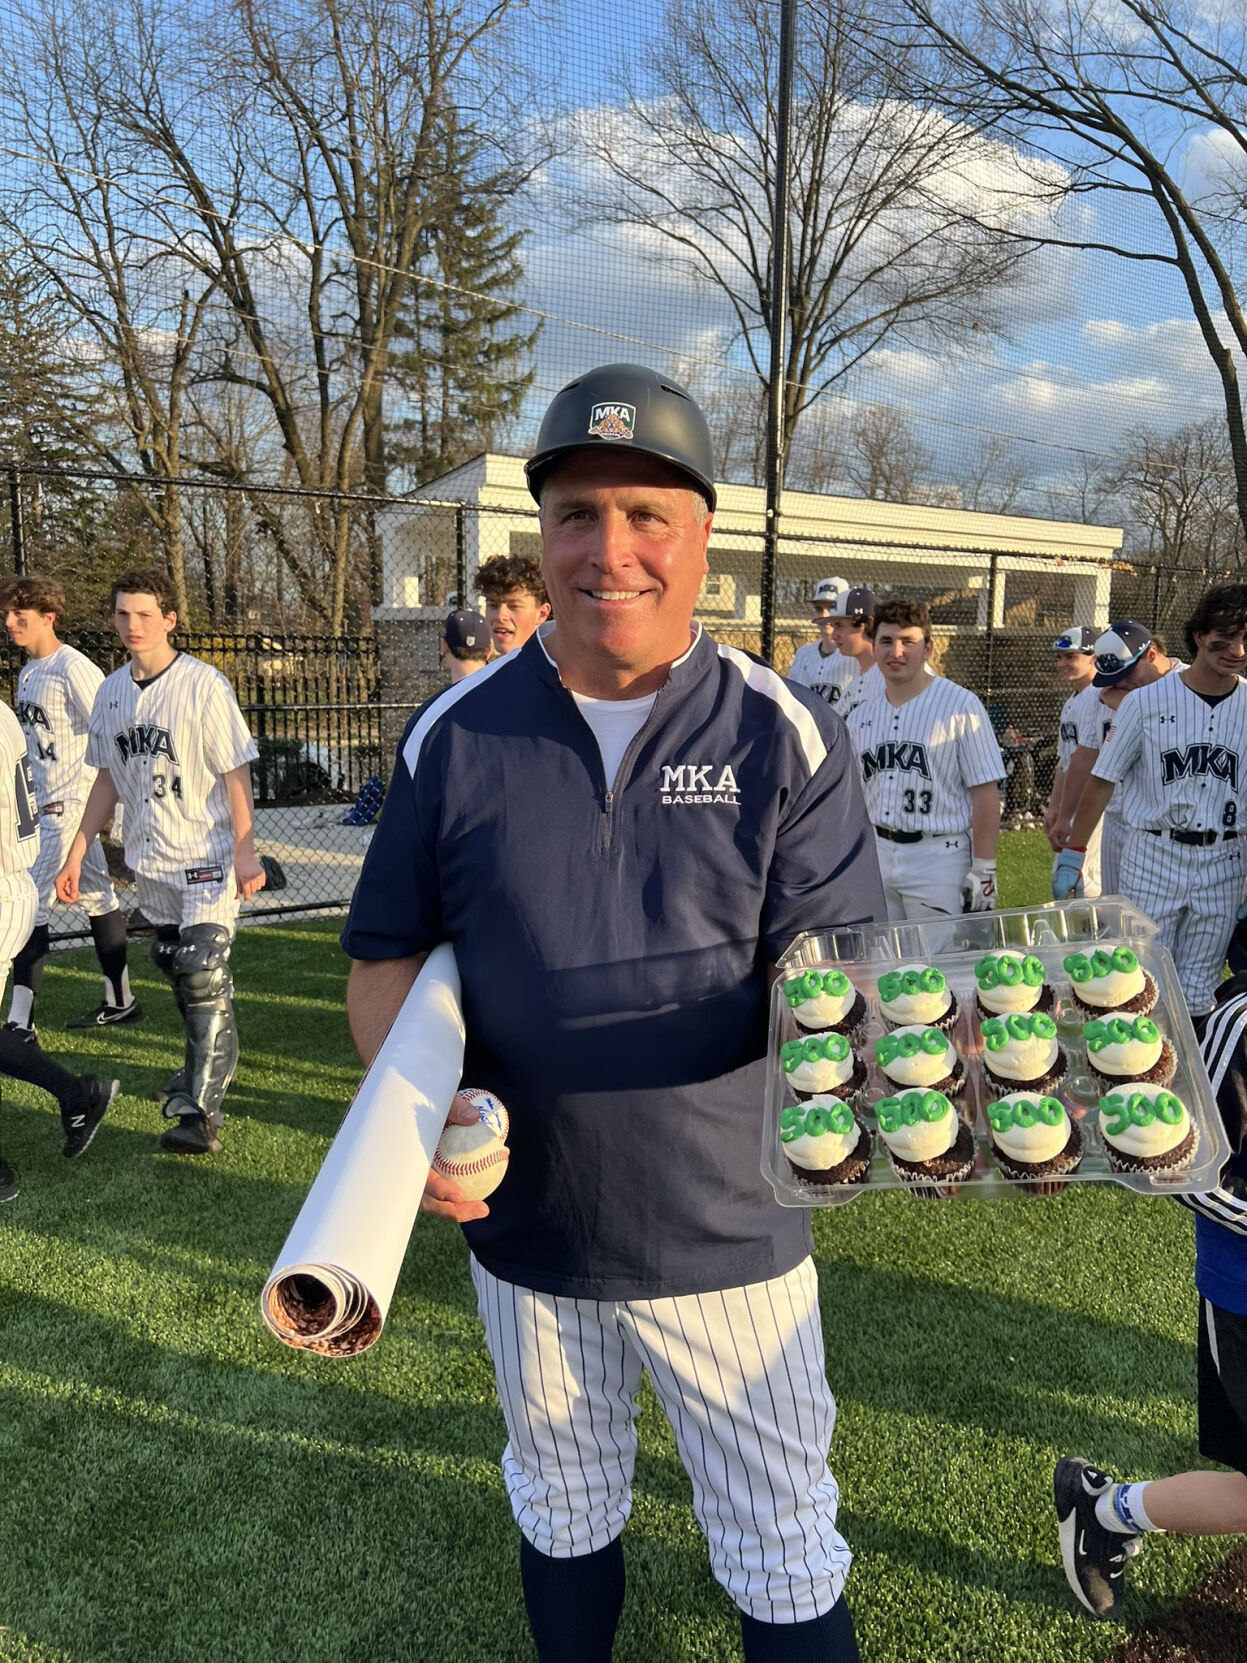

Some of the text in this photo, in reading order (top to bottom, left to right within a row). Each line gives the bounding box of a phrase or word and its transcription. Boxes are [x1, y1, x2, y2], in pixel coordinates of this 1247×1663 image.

[594, 406, 630, 422] MKA
[660, 764, 741, 793] MKA
[861, 741, 932, 782] MKA
[1160, 743, 1239, 794] MKA
[152, 774, 182, 800] 34
[662, 794, 742, 805] BASEBALL
[904, 789, 933, 815] 33
[1222, 800, 1237, 826] 8
[975, 956, 1044, 990] 500
[1064, 949, 1137, 982] 500
[784, 971, 848, 1007] 500
[878, 969, 944, 1002] 500
[877, 1030, 947, 1066] 500
[981, 1014, 1055, 1051] 500
[1083, 1018, 1157, 1052] 500
[782, 1036, 848, 1072] 500
[782, 1104, 853, 1142] 500
[874, 1093, 948, 1132] 500
[989, 1098, 1063, 1132] 500
[1100, 1095, 1181, 1135] 500
